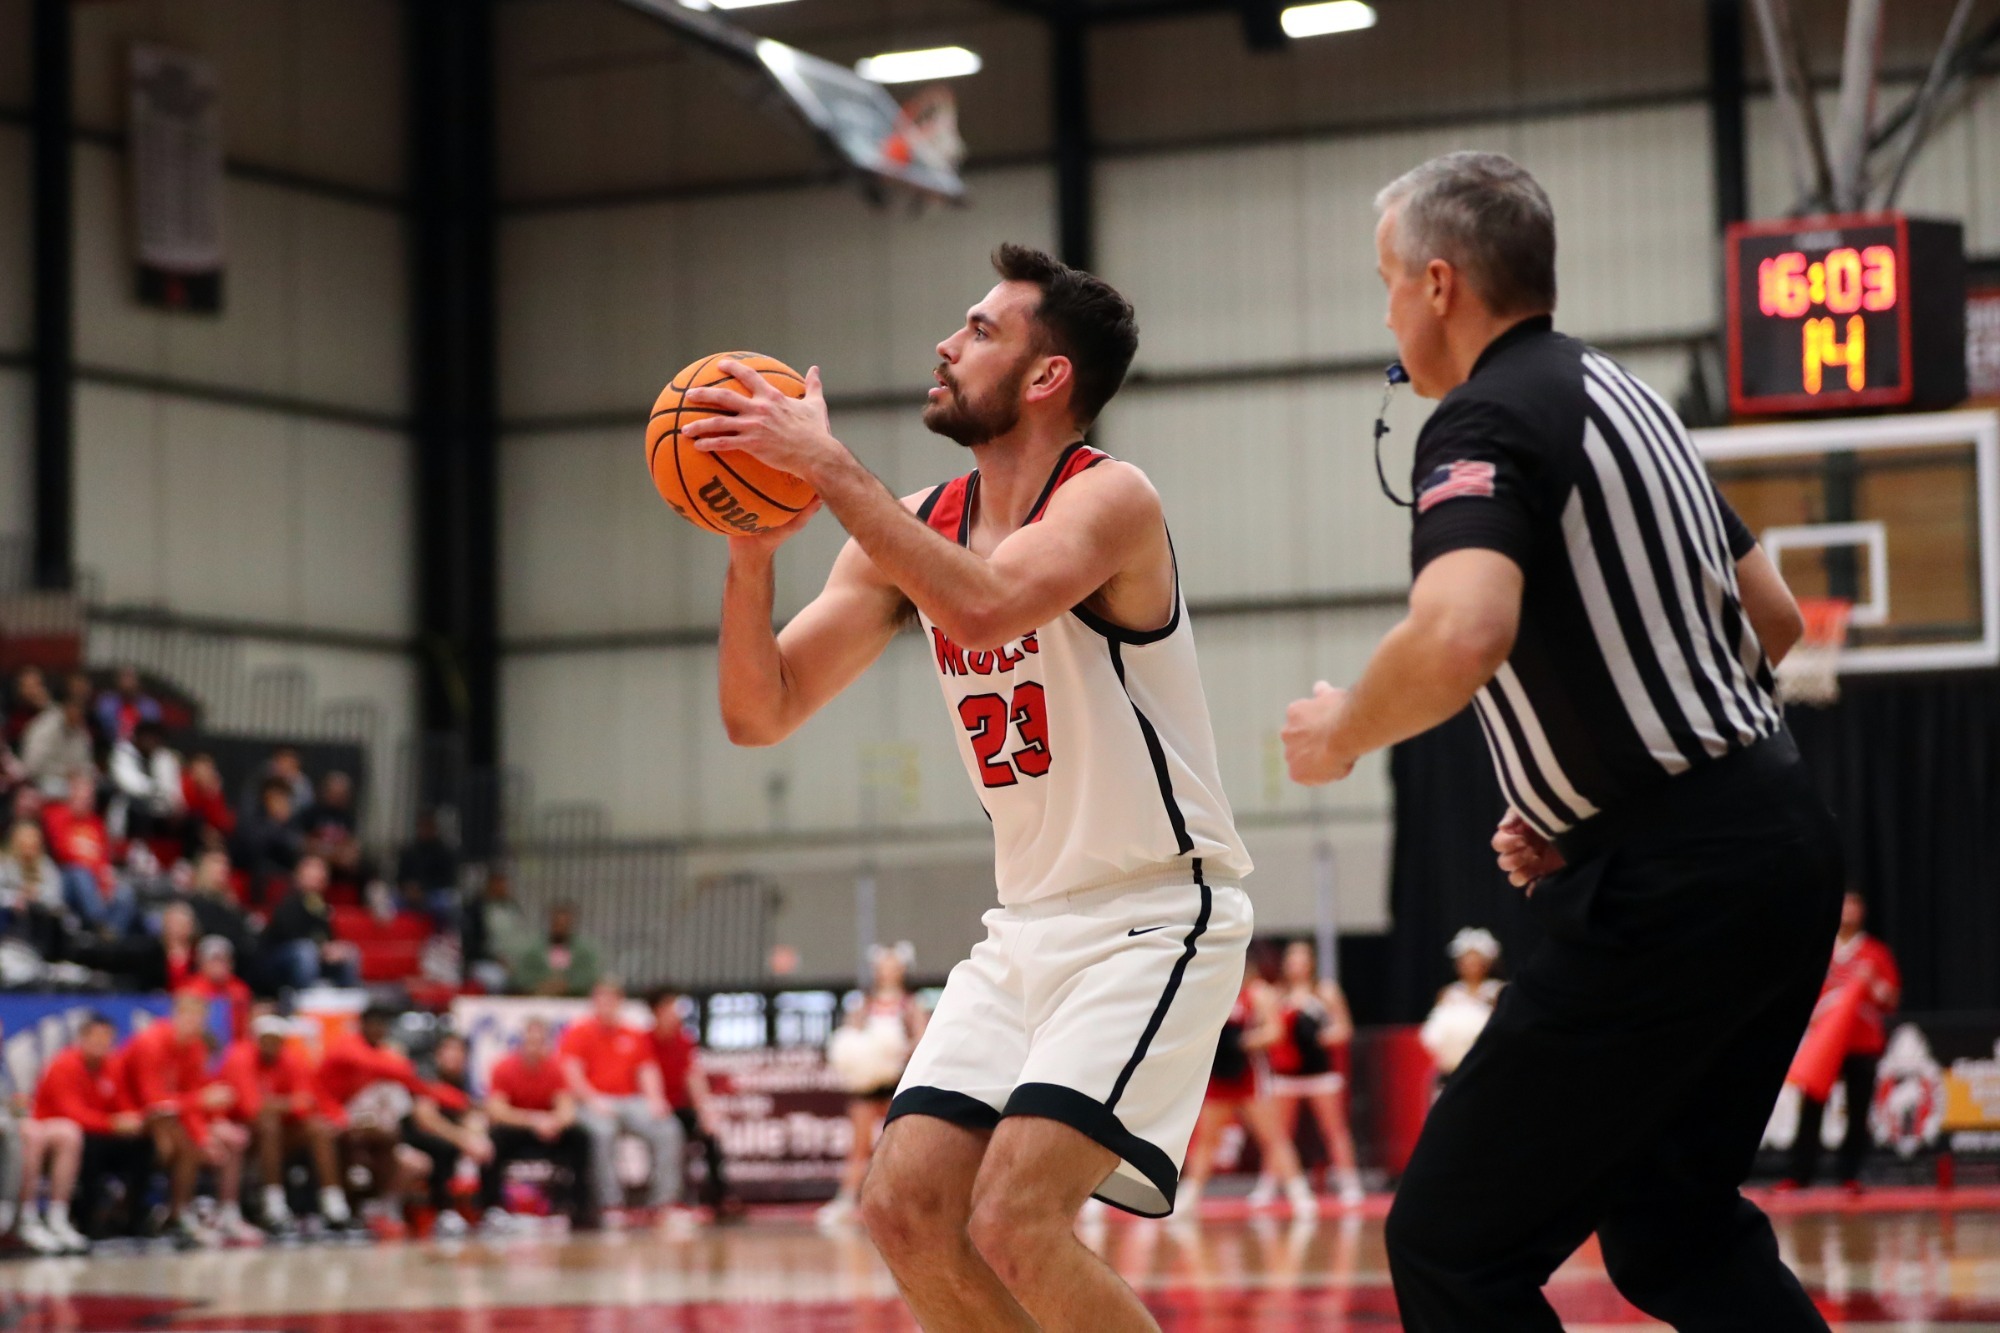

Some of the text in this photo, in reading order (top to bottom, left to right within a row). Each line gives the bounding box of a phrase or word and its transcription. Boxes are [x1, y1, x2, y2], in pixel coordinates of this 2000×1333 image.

[1758, 245, 1896, 318] 16:03
[1803, 314, 1865, 395] 14
[958, 680, 1052, 788] 23
